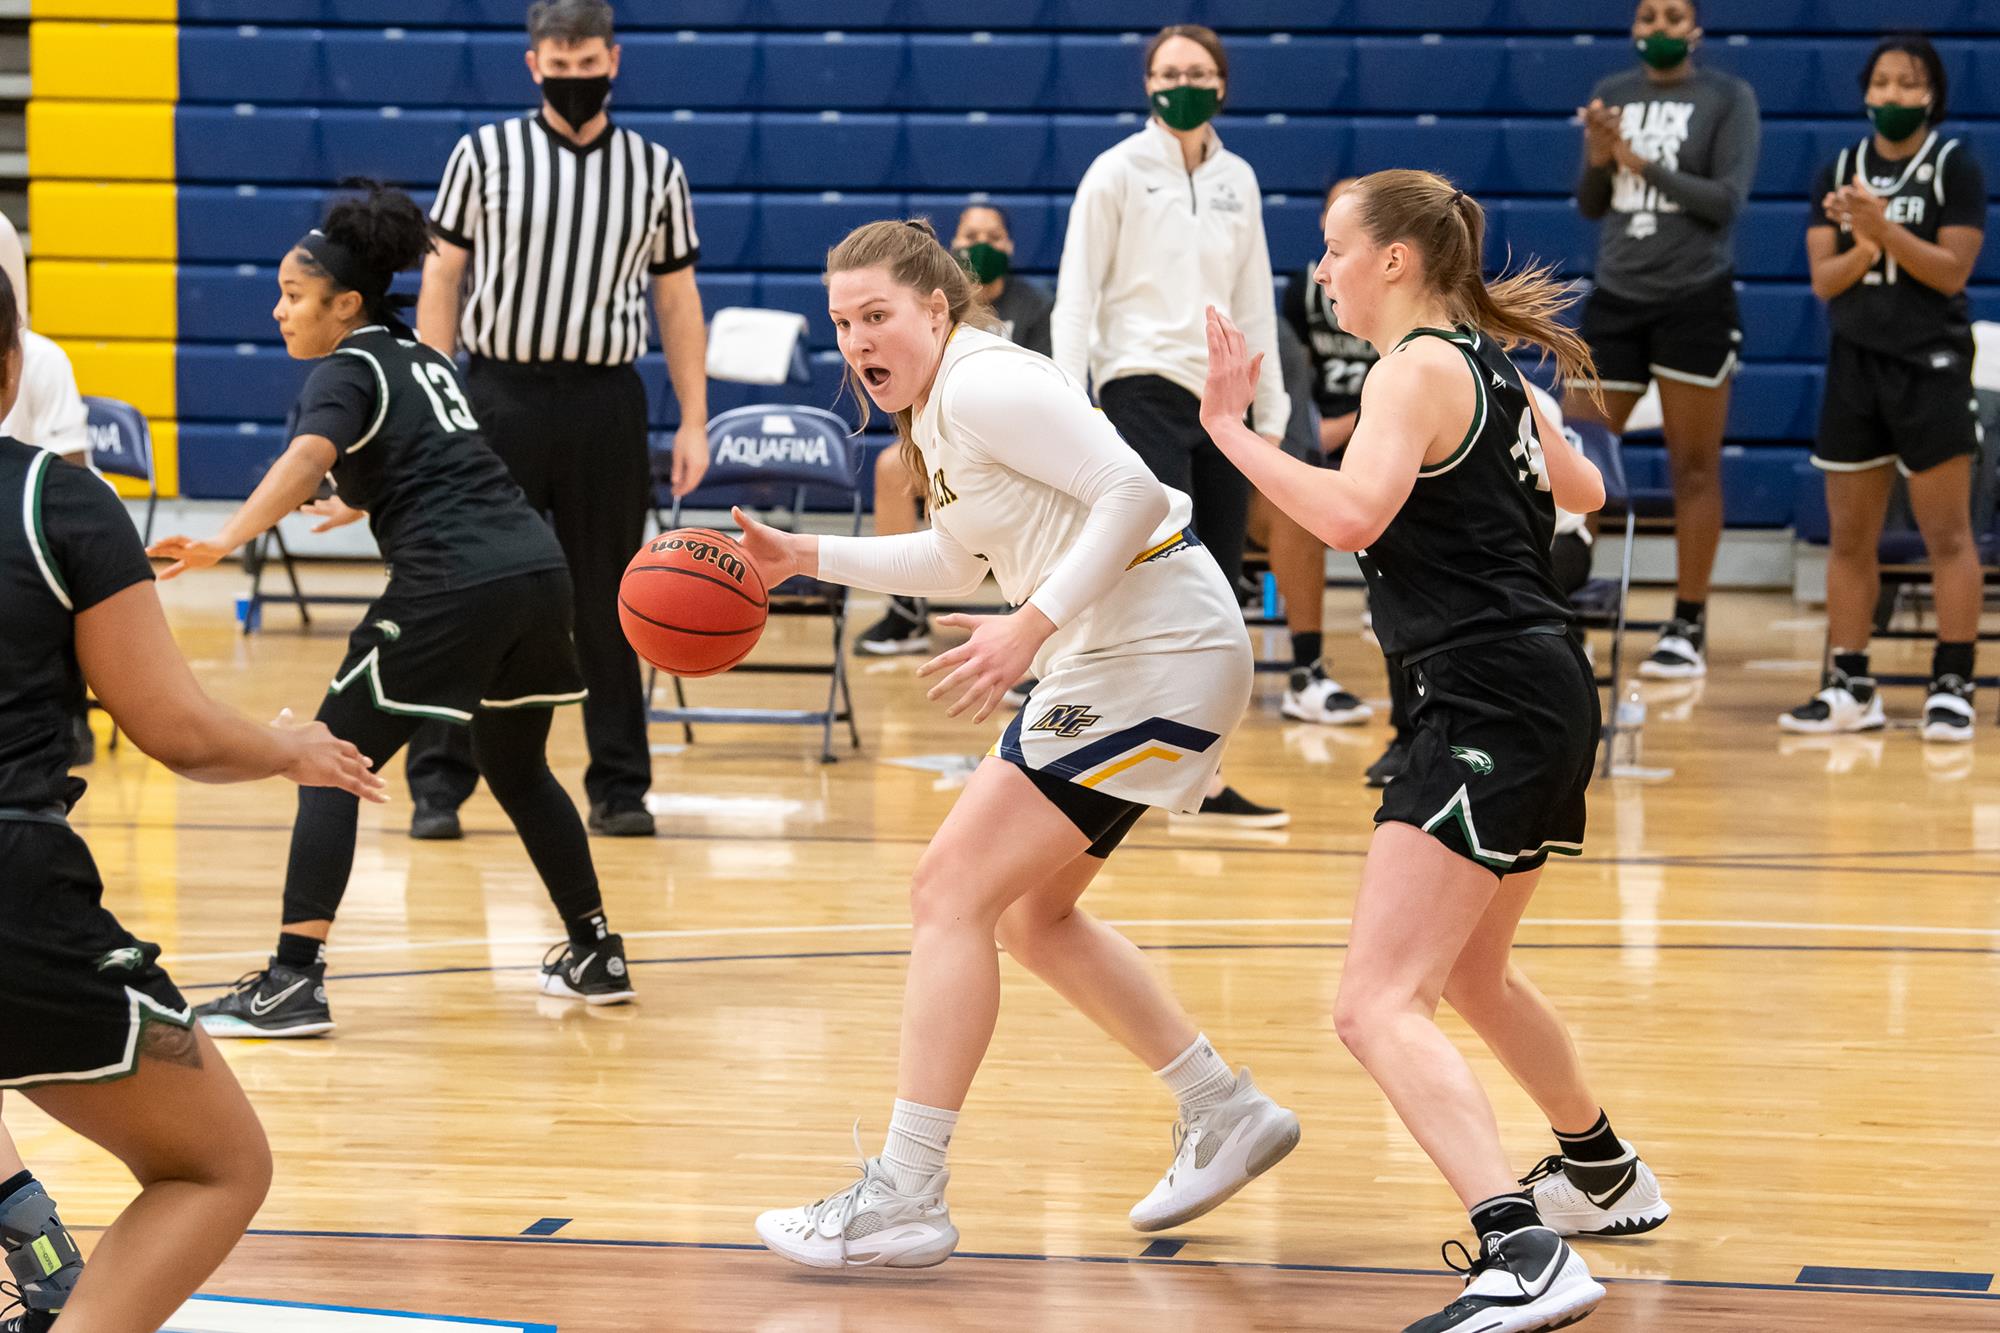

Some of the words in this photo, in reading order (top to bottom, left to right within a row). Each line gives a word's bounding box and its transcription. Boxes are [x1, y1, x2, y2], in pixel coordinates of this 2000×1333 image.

[411, 361, 479, 433] 13
[715, 434, 830, 467] AQUAFINA
[650, 539, 747, 584] Wilson
[1028, 704, 1103, 738] MC
